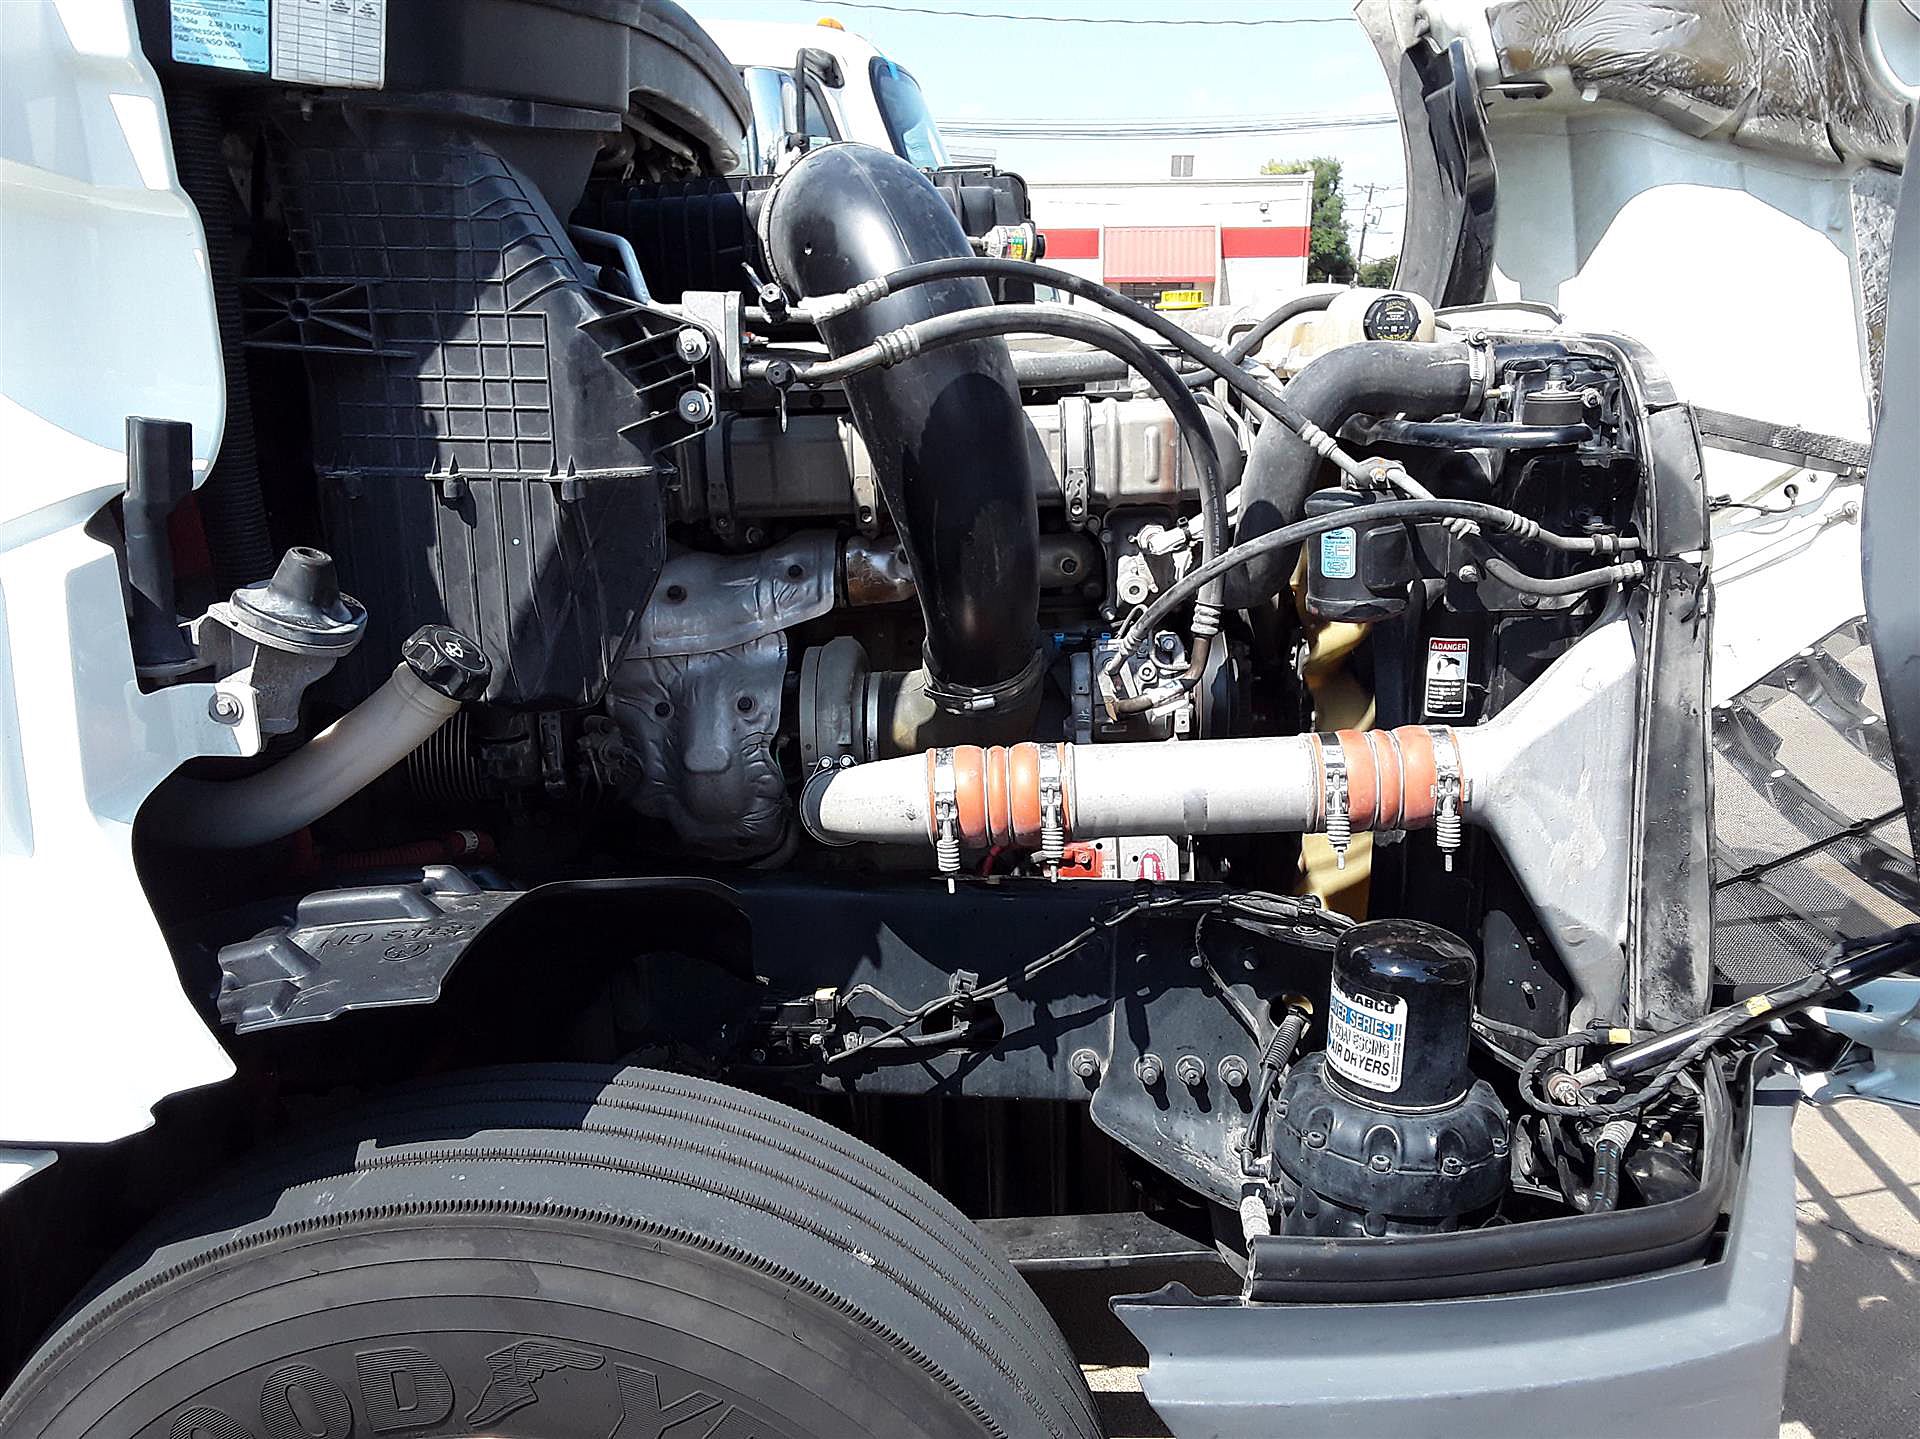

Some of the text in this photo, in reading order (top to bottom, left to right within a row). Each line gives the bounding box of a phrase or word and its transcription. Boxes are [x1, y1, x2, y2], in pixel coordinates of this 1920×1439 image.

[1439, 643, 1466, 651] DANGER
[319, 932, 374, 951] NO
[1348, 1010, 1392, 1040] SERIES
[1331, 1040, 1343, 1058] AIR
[1343, 1047, 1391, 1077] DRYERS
